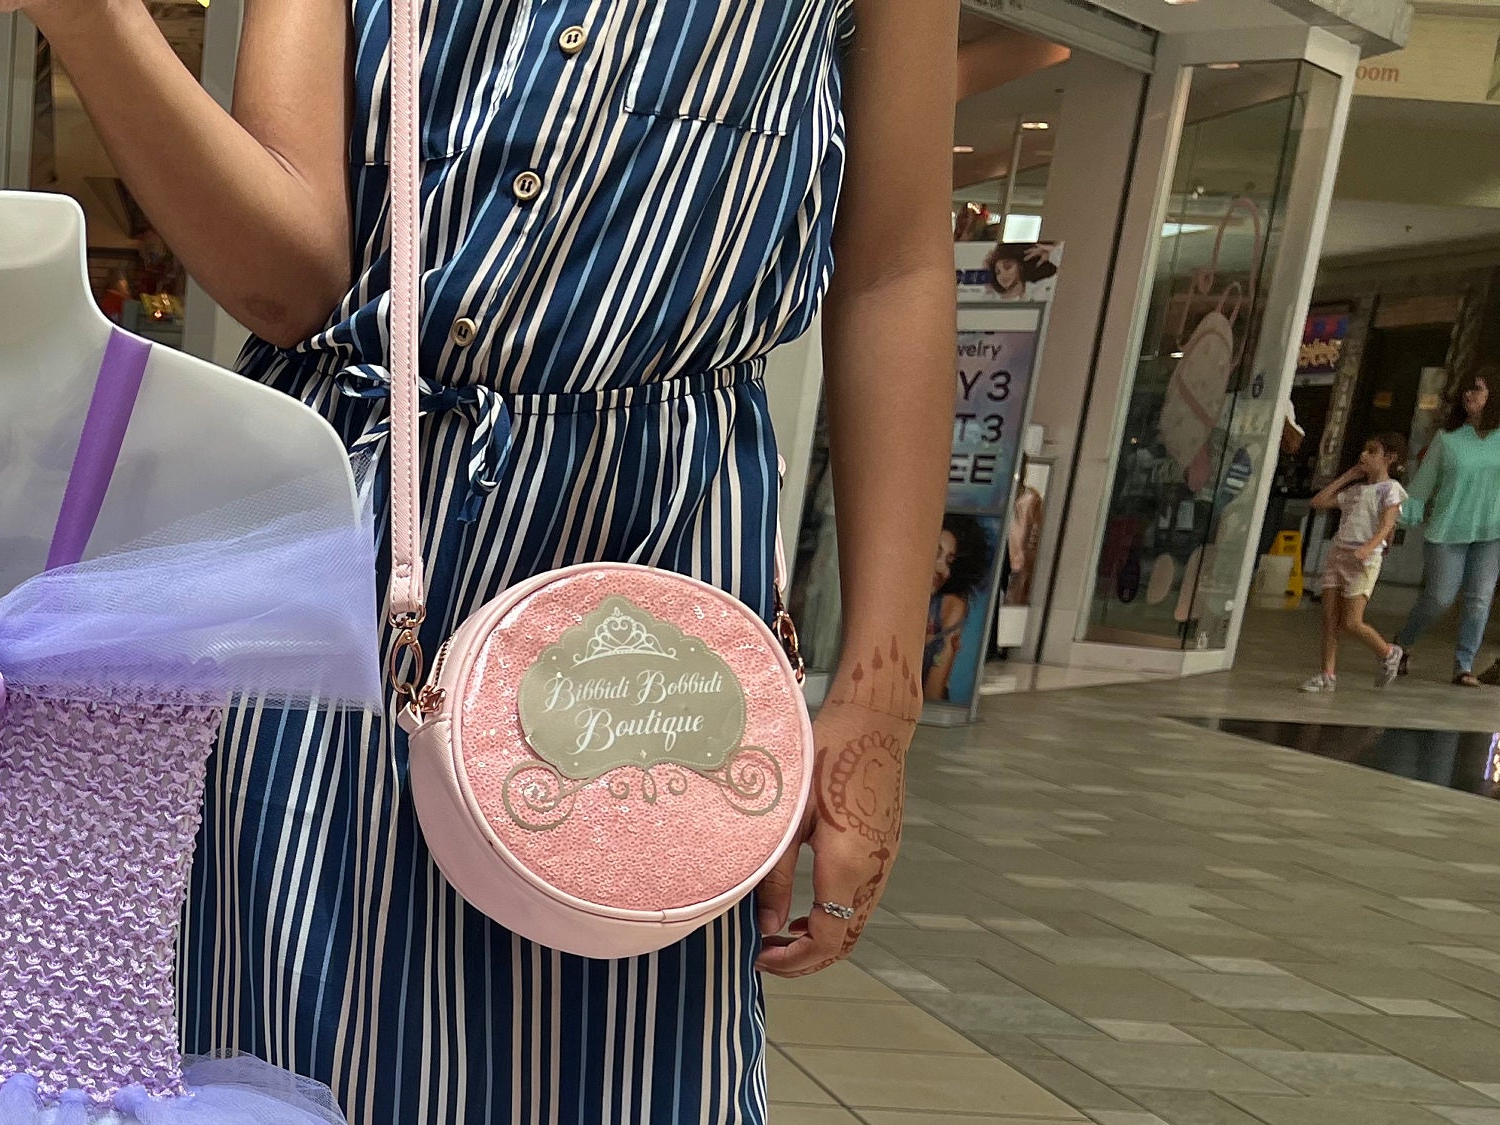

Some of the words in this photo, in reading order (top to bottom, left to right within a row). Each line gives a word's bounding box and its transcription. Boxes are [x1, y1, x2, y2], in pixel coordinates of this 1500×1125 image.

[986, 369, 1012, 402] 3
[981, 414, 1005, 443] 3
[540, 674, 630, 714] Bibbidi
[630, 669, 723, 706] Bobbidi
[565, 706, 705, 756] Boutique
